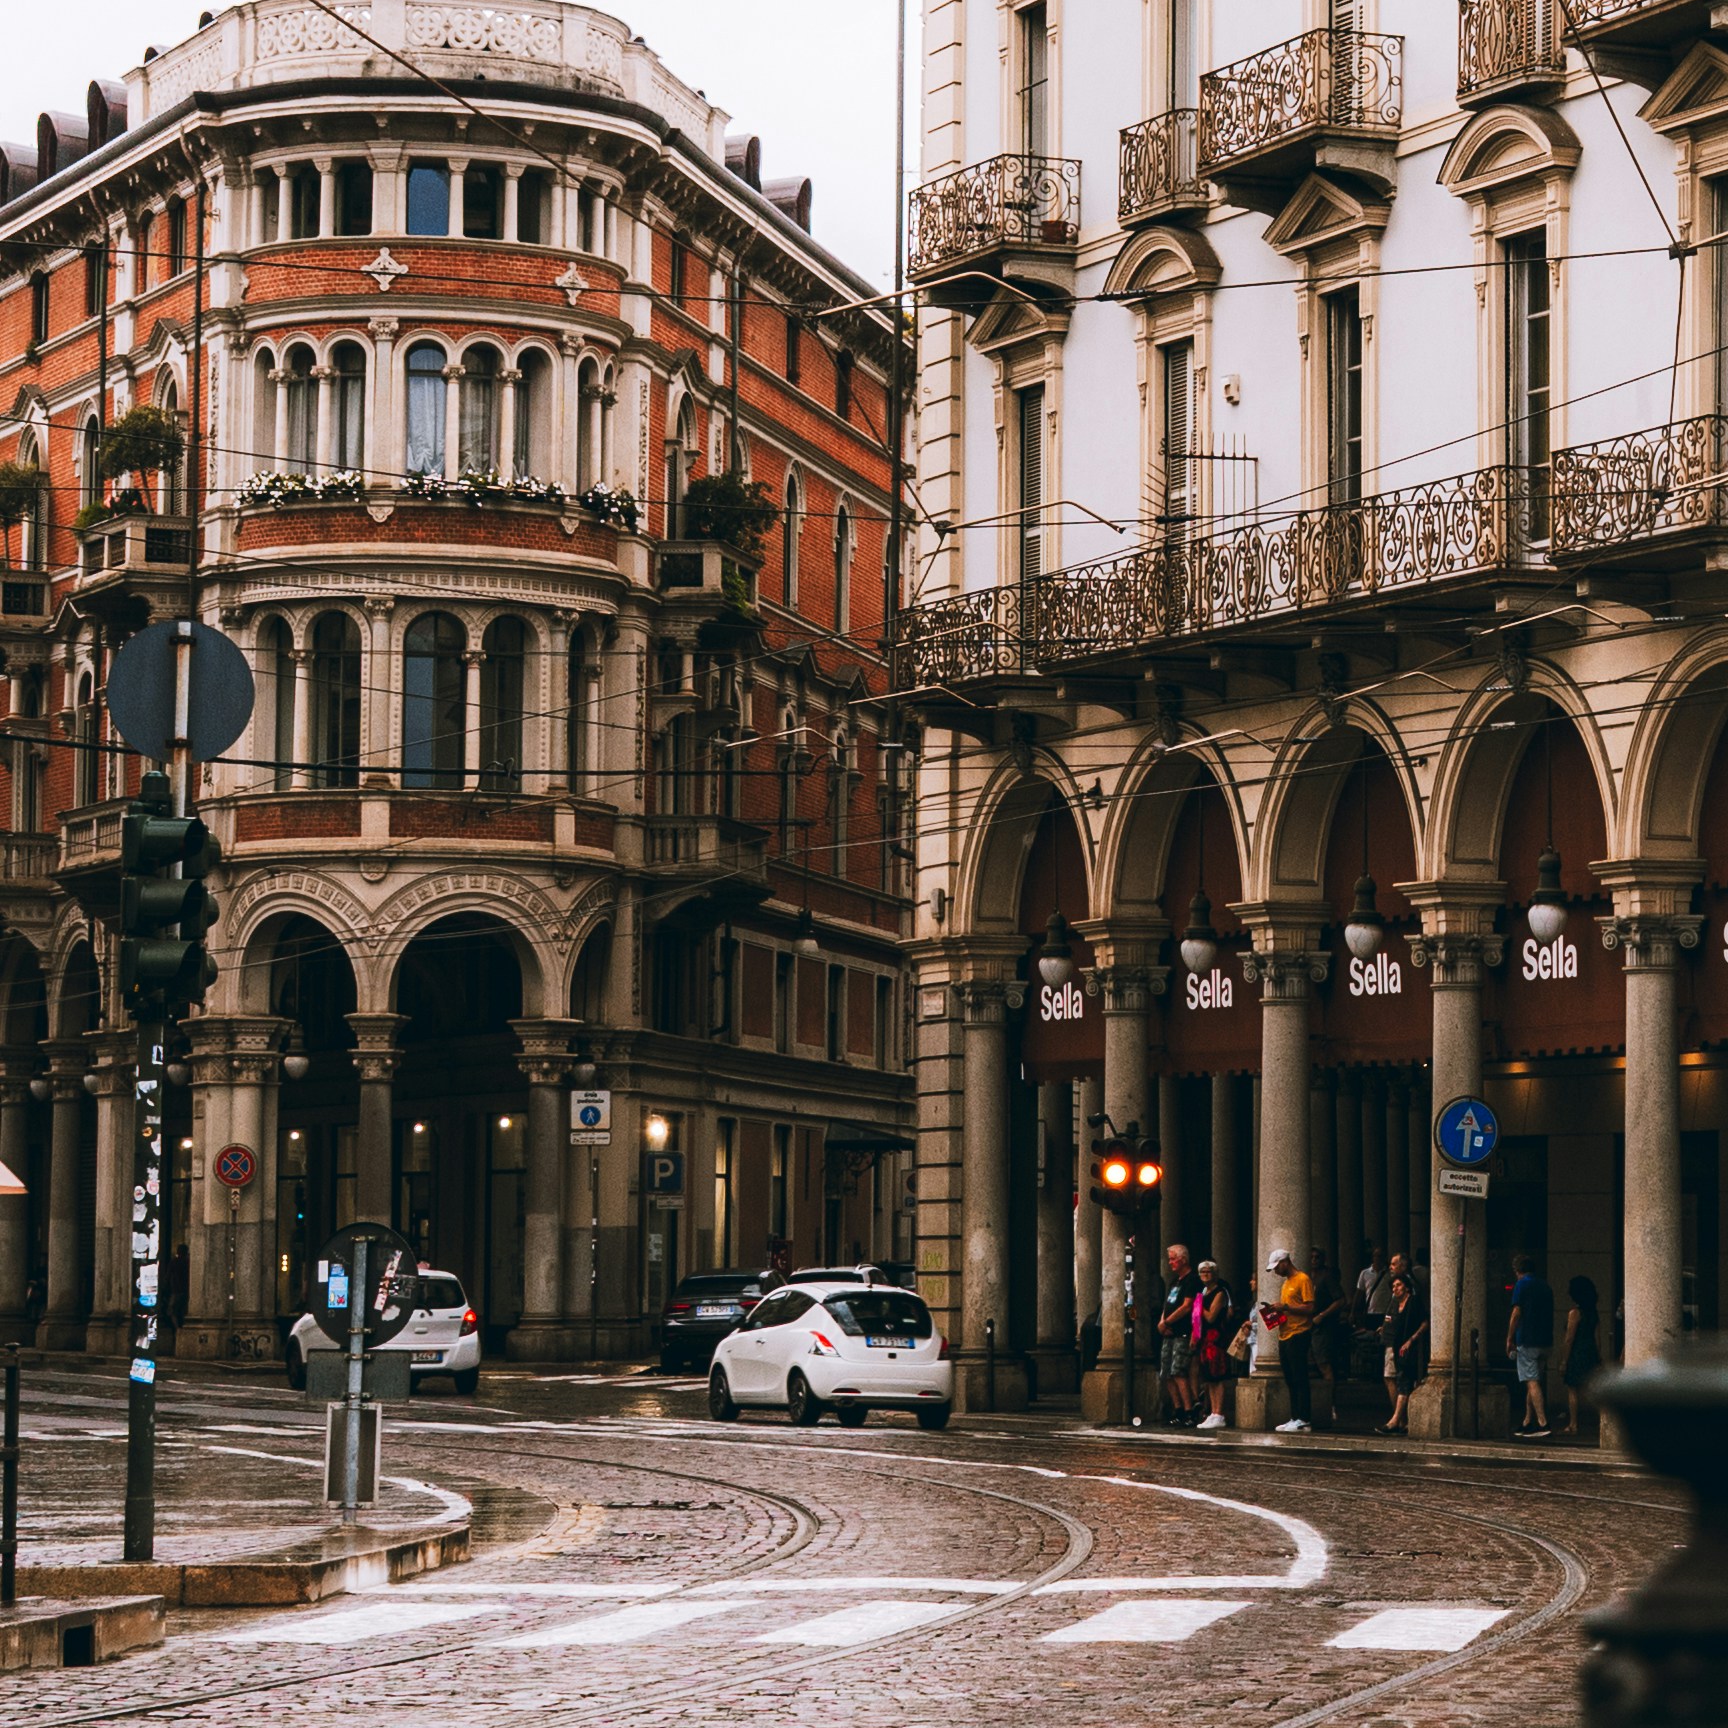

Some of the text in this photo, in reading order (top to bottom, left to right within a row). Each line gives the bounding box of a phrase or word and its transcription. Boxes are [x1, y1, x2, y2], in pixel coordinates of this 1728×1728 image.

[1349, 953, 1402, 997] Sella
[1522, 935, 1578, 981] Sella
[1040, 982, 1083, 1021] Sella
[1186, 969, 1233, 1010] Sella
[654, 1158, 675, 1188] P
[1443, 1183, 1482, 1193] autorizzati
[1449, 1173, 1478, 1182] eccetto
